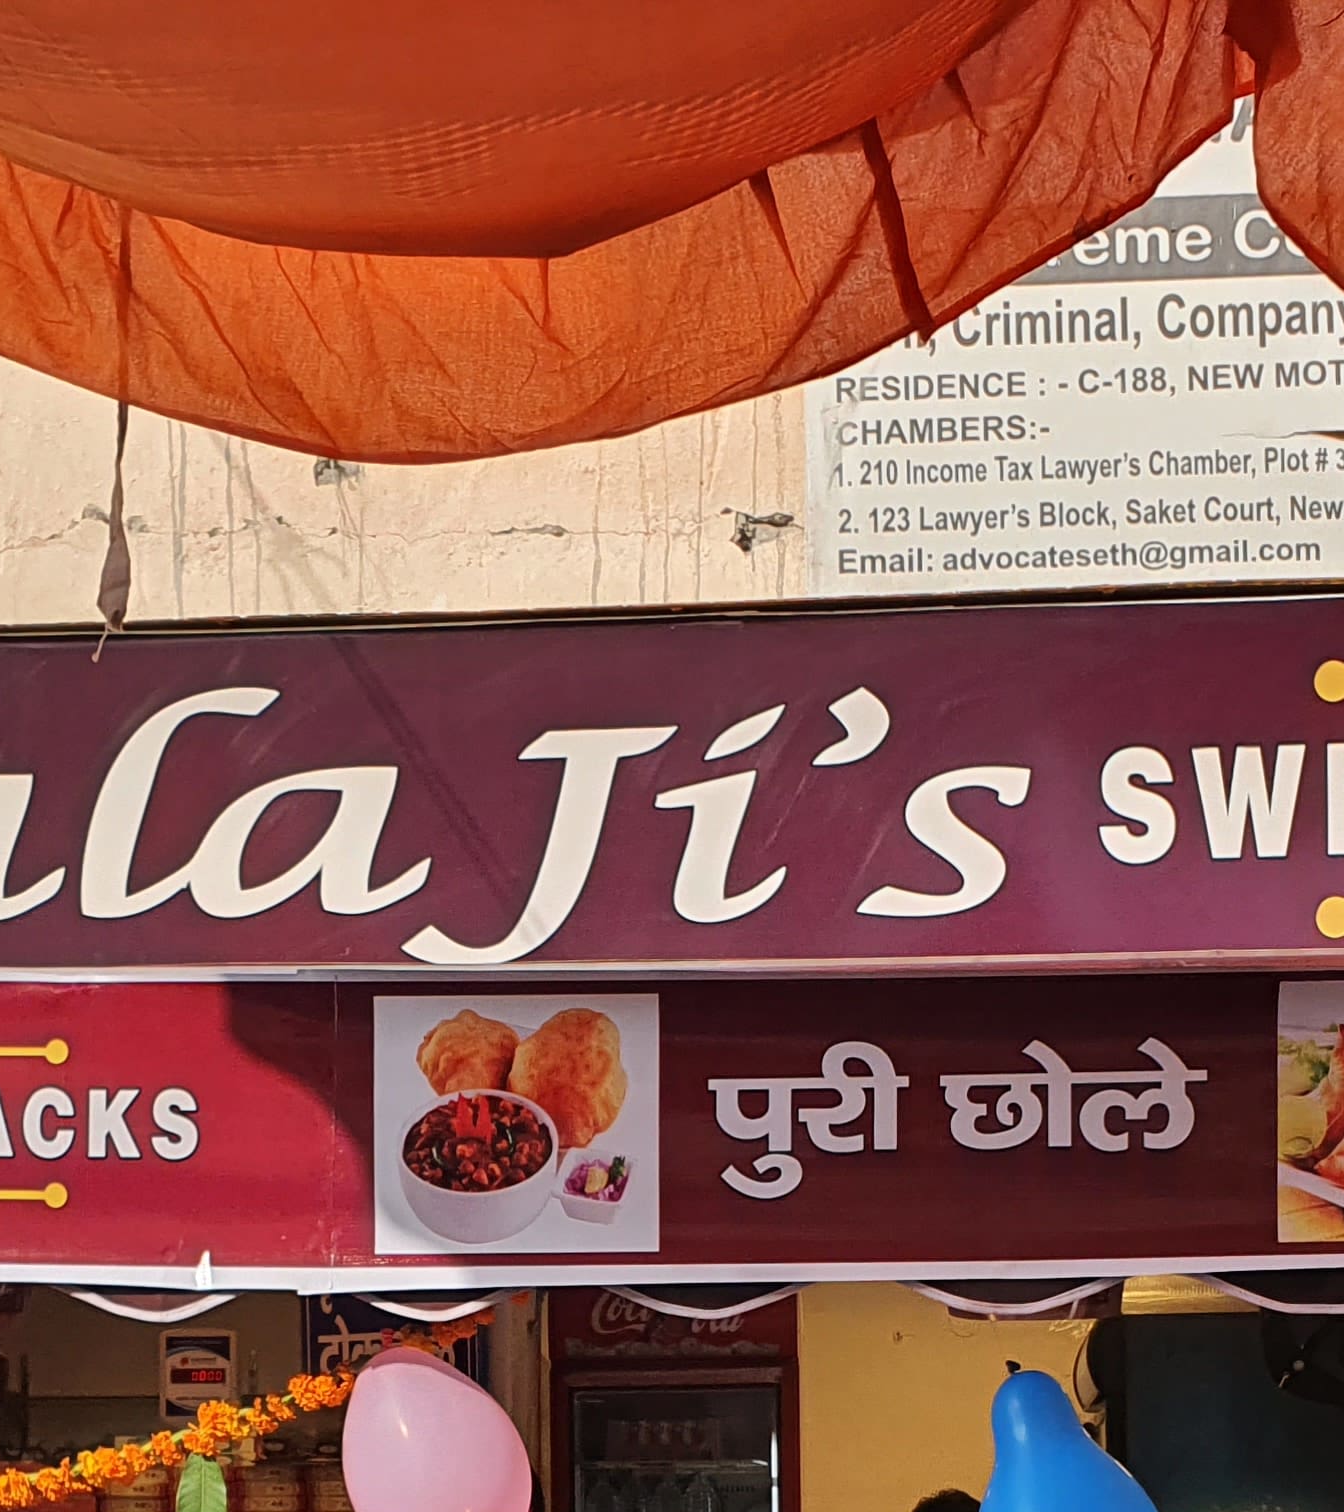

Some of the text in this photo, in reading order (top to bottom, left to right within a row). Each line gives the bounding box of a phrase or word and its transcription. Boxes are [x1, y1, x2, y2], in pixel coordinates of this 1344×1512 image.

[1047, 209, 1306, 266] eme C
[953, 295, 1142, 351] Criminal,
[835, 371, 1027, 404] RESIDENCE
[1077, 367, 1177, 397] C-188,
[1187, 364, 1264, 391] NEW
[837, 414, 1051, 446] CHAMBERS:-
[833, 461, 854, 488] 1.
[859, 459, 898, 486] 210
[906, 458, 987, 485] Income
[994, 455, 1033, 482] Tax
[1041, 452, 1141, 485] Lawyer's
[1148, 449, 1257, 480] Chamber,
[1264, 446, 1309, 474] Plot
[1315, 446, 1330, 472] #
[837, 508, 860, 535] 2.
[867, 505, 911, 533] 123
[919, 503, 1031, 537] Lawyer's
[1039, 500, 1118, 530] Block,
[1125, 498, 1196, 526] Saket
[1204, 495, 1281, 527] Court,
[1289, 495, 1344, 521] New
[837, 540, 1322, 575] Email: advocateseth@gmail.com
[400, 685, 1033, 967] Ji's
[708, 1036, 1208, 1200] पुरी छोले
